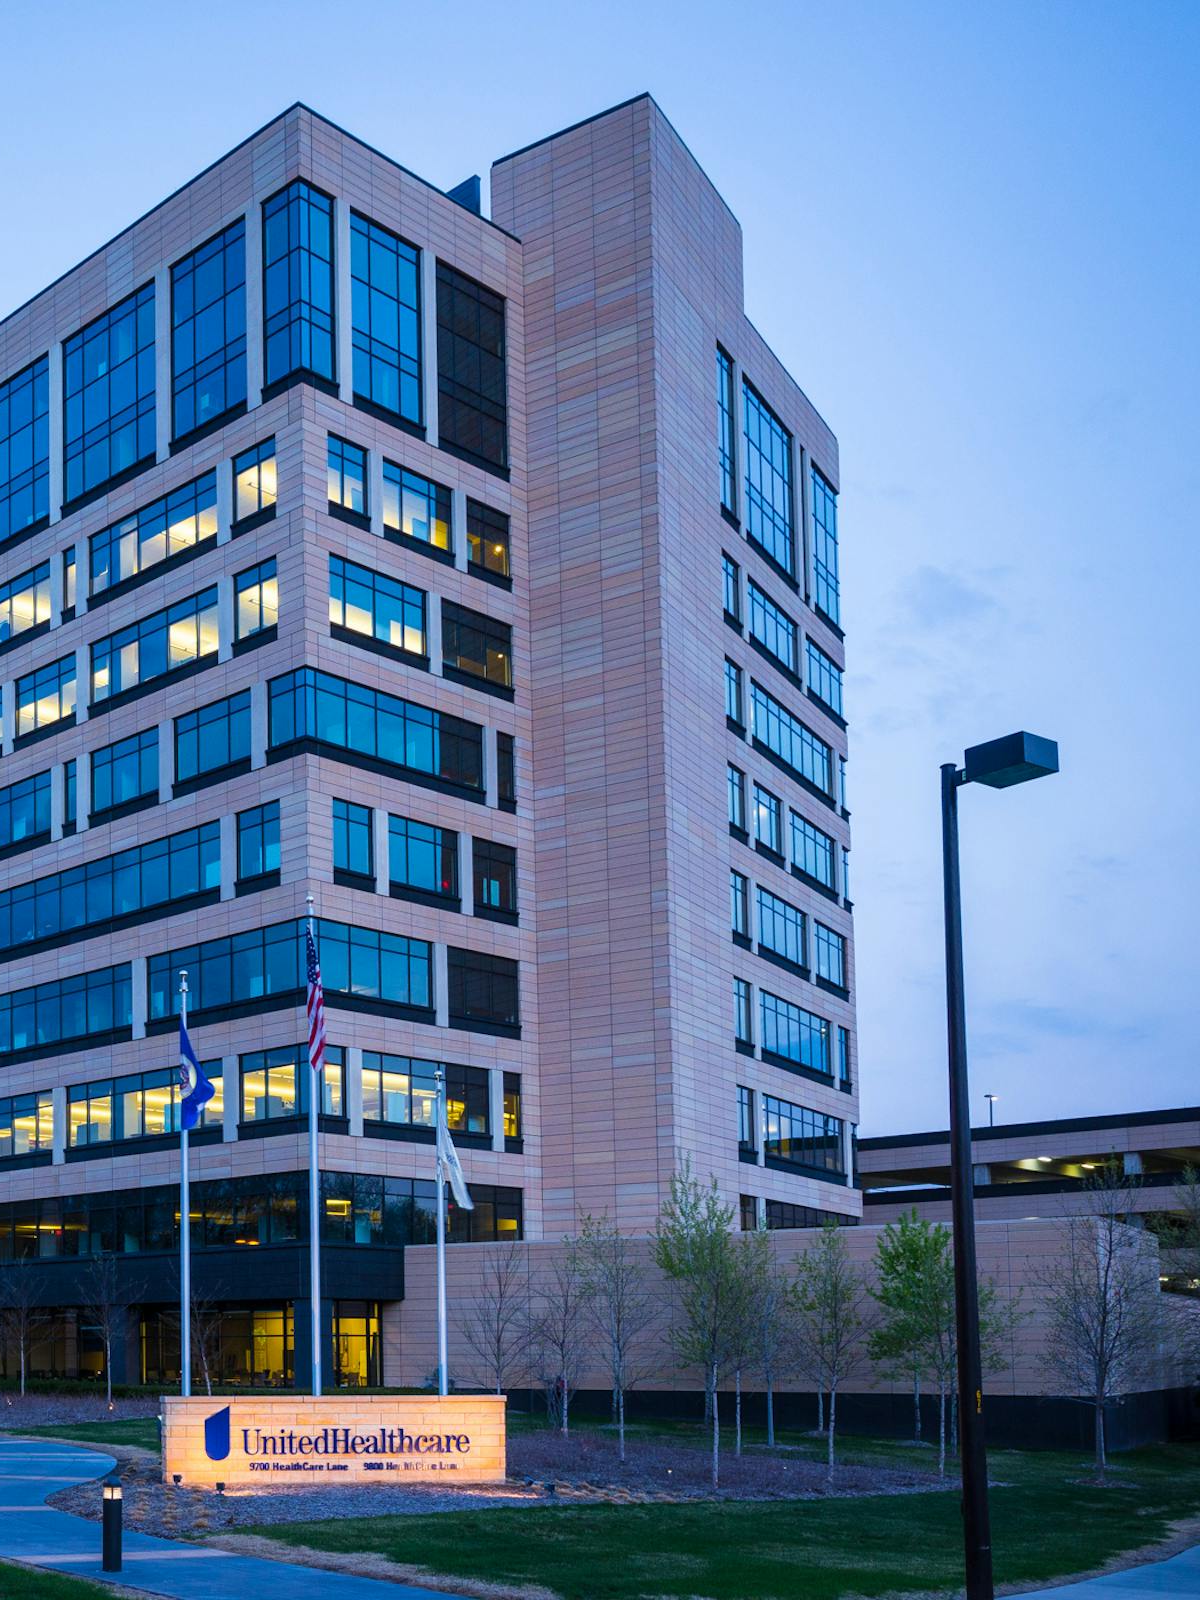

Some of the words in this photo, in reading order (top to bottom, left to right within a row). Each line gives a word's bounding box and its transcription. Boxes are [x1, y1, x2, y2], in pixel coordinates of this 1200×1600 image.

[241, 1428, 470, 1456] UnitedHealthcare
[249, 1462, 270, 1471] 9700
[273, 1462, 324, 1471] HealthCare
[327, 1462, 349, 1471] Lane
